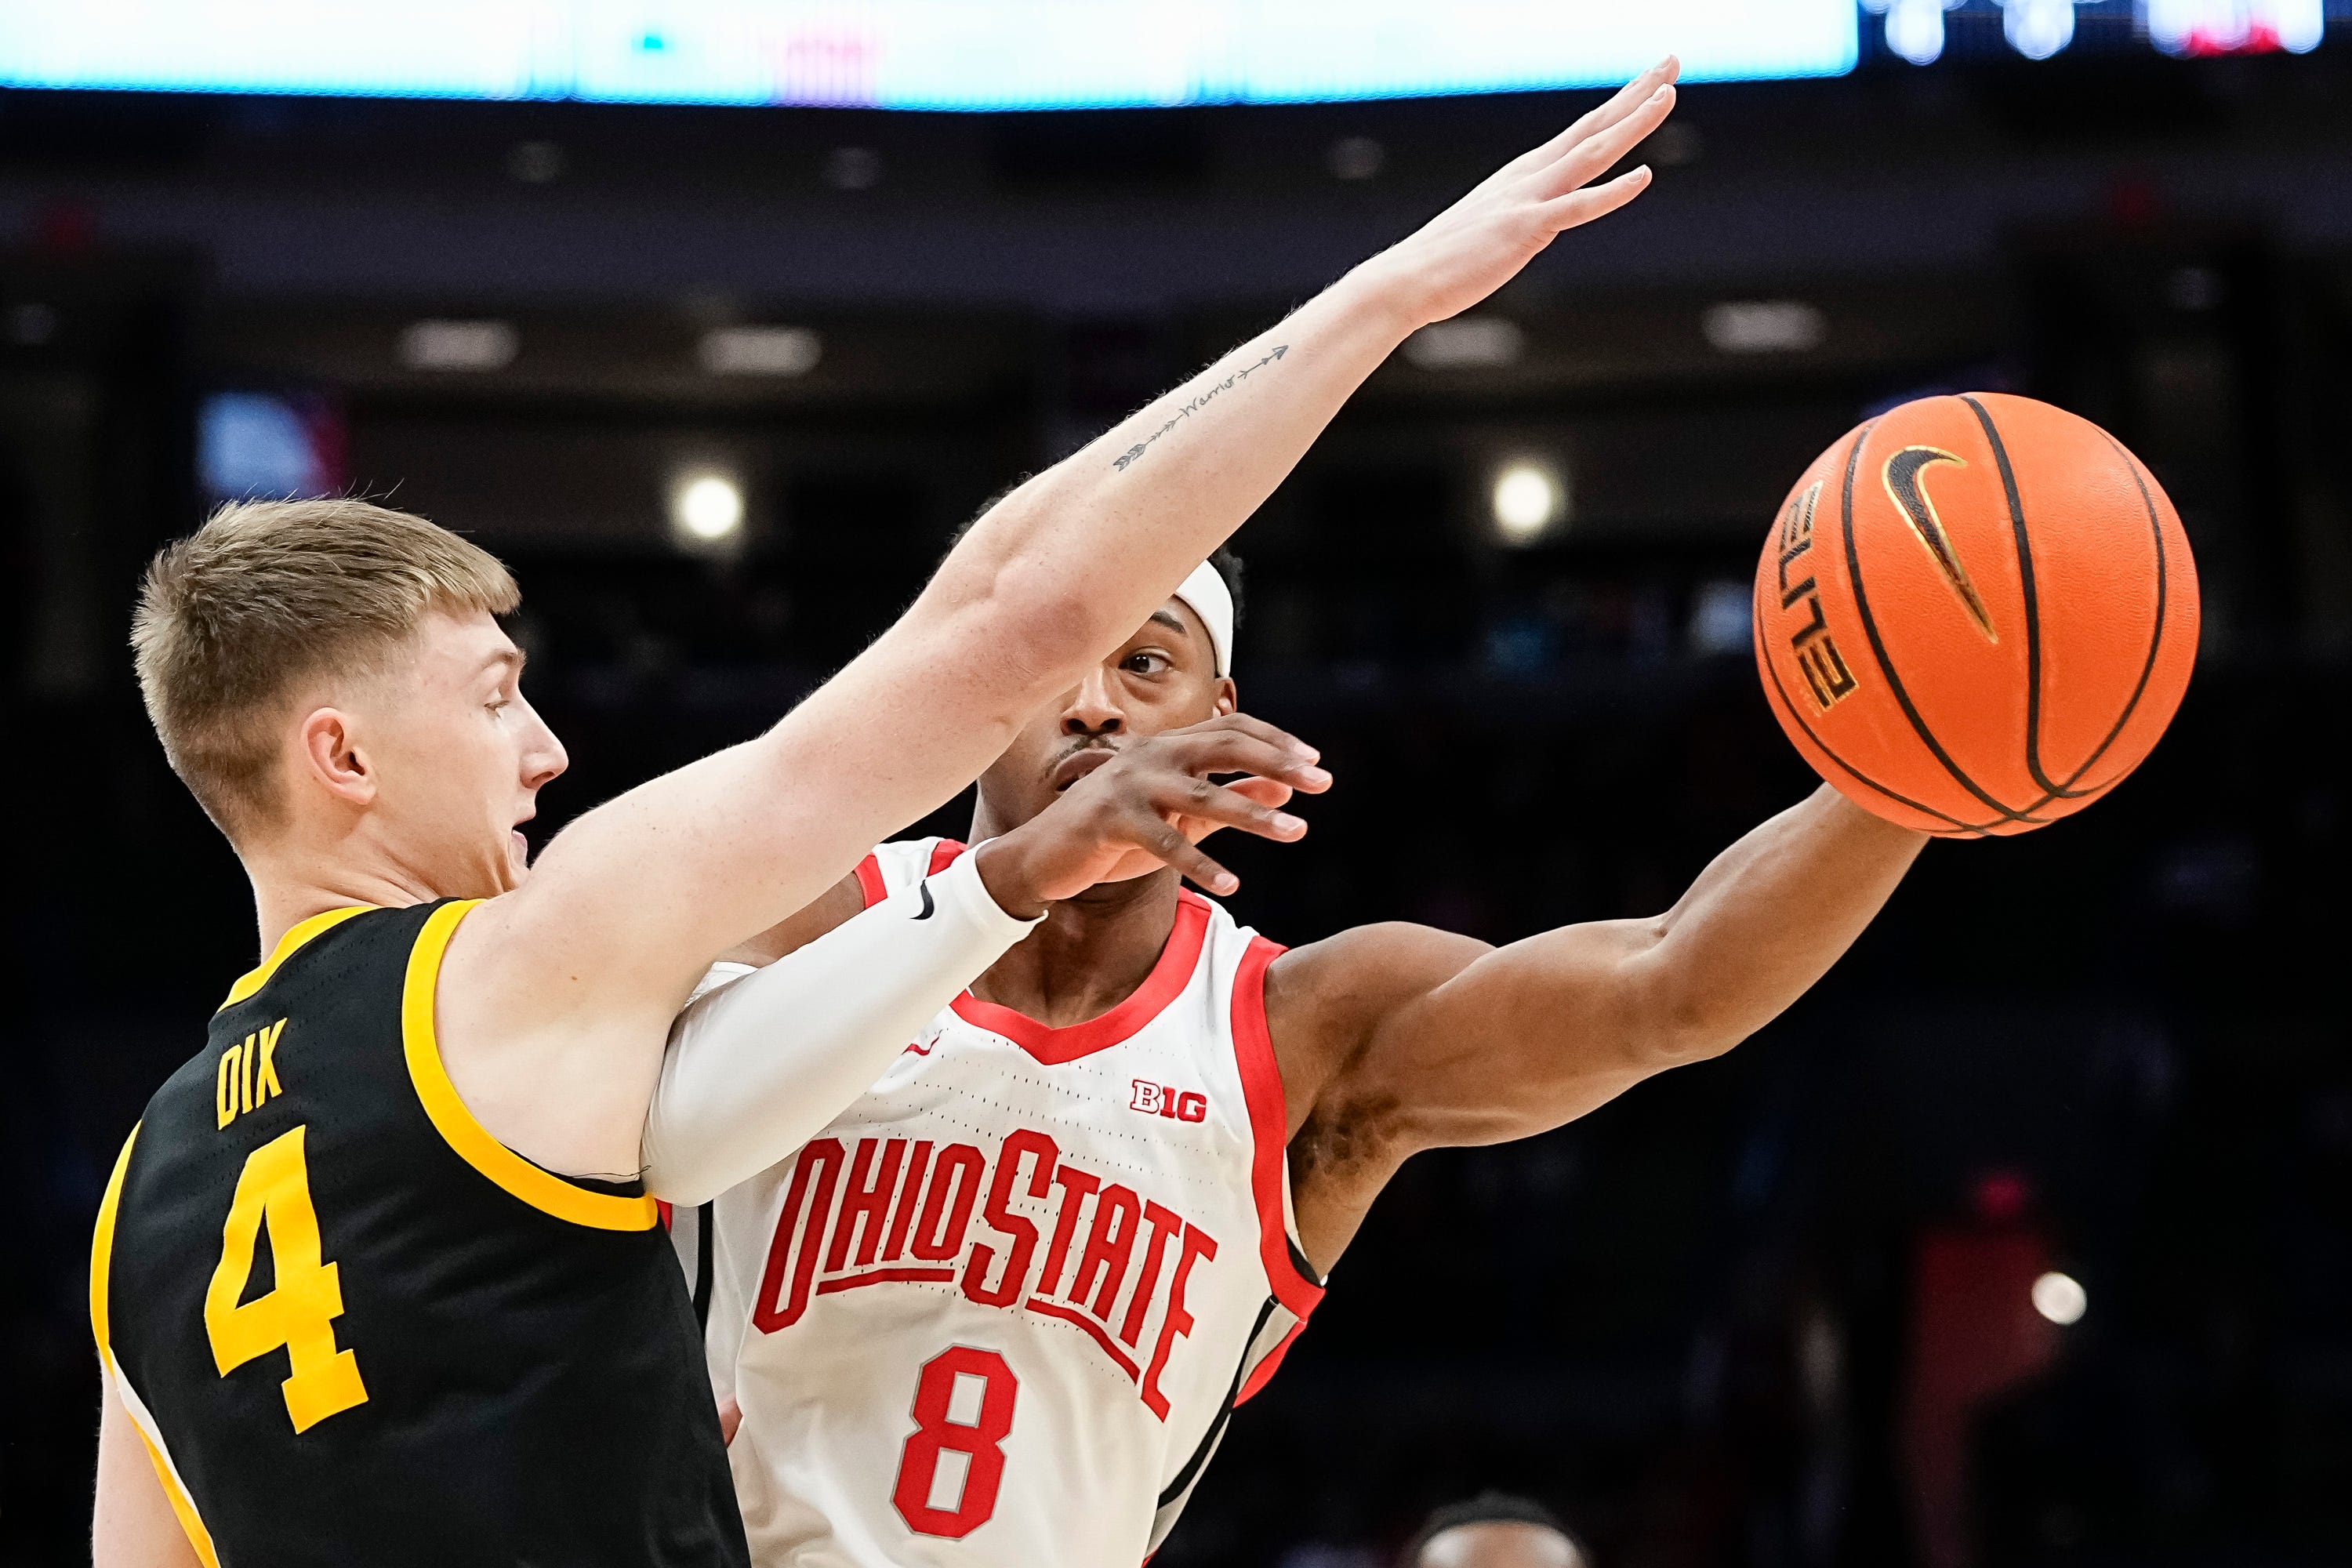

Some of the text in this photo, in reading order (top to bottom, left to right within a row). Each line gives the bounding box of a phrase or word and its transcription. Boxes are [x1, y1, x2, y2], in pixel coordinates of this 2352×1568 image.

[1778, 481, 1858, 713] ELITE
[204, 1124, 369, 1436] 4
[889, 1342, 1019, 1541] 8
